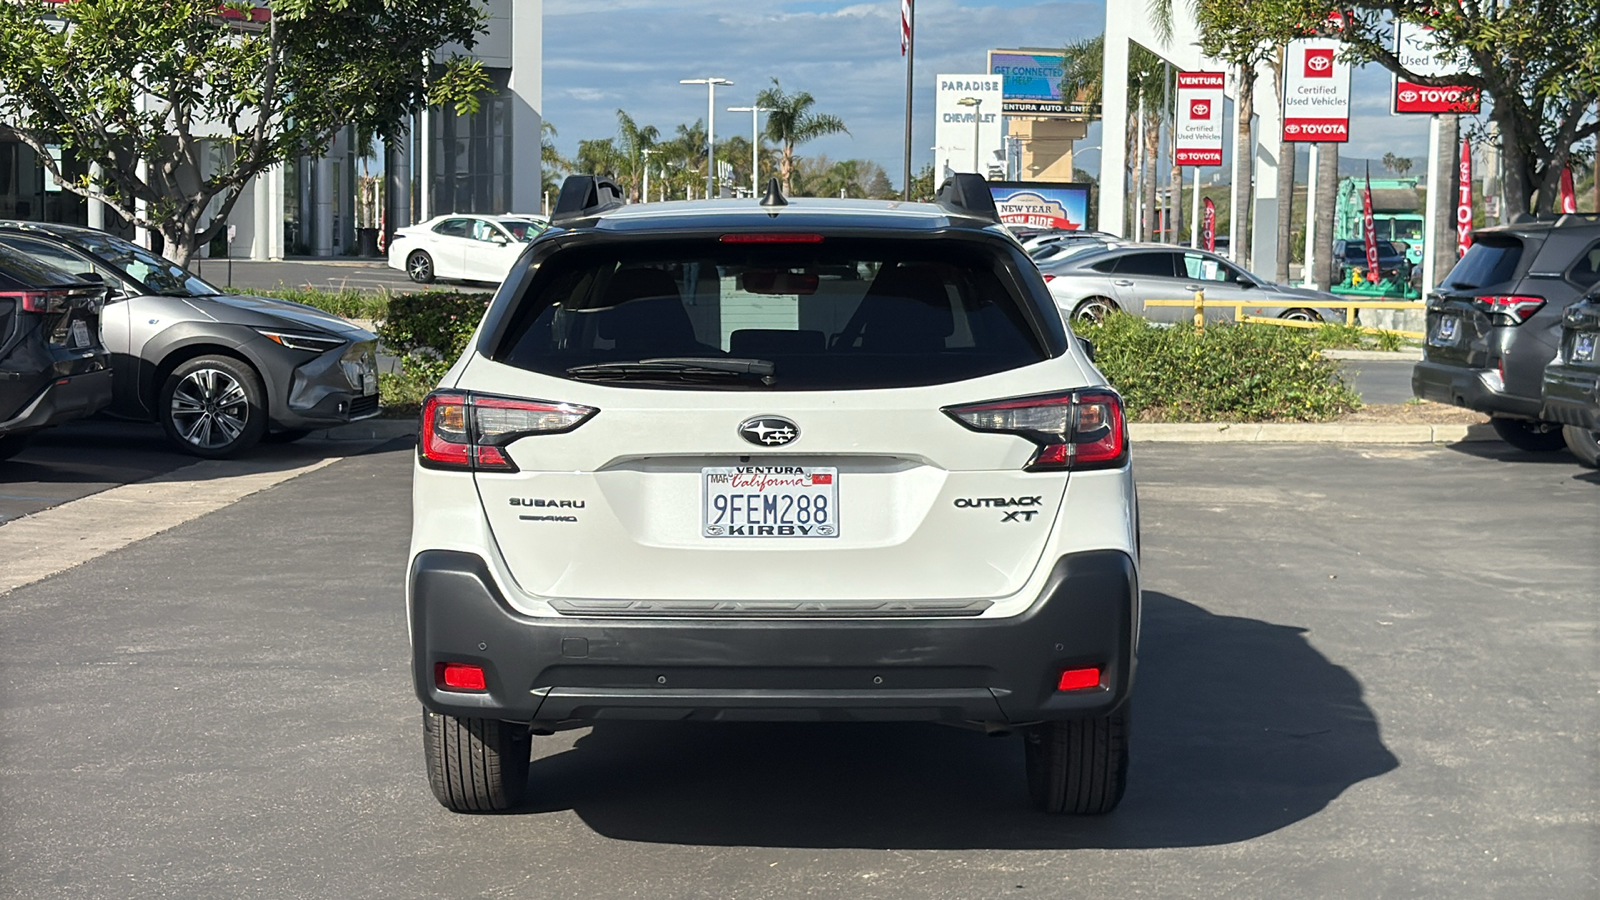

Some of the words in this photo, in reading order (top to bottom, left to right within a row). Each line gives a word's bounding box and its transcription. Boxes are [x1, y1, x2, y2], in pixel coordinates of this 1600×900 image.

[1401, 55, 1429, 66] Used
[994, 66, 1011, 75] GET
[1012, 66, 1064, 77] CONNECTED
[1012, 76, 1033, 85] HELP
[1180, 77, 1223, 85] VENTURA
[941, 81, 999, 91] PARADISE
[1297, 86, 1337, 95] Certified
[1286, 97, 1309, 106] Used
[1311, 97, 1347, 106] Vehicles
[1419, 90, 1478, 103] TOYO
[1002, 103, 1037, 111] ENTURA
[1301, 124, 1346, 134] TOYOTA
[1001, 204, 1024, 213] NEW
[1025, 205, 1052, 214] YEAR
[1027, 216, 1054, 228] RIDE
[736, 466, 804, 474] VENTURA
[732, 473, 812, 492] California
[509, 497, 585, 508] SUBARU
[953, 496, 1042, 508] OUTBACK
[713, 494, 828, 525] 9FEM288
[1000, 510, 1039, 522] XT
[728, 525, 813, 535] KIRBY
